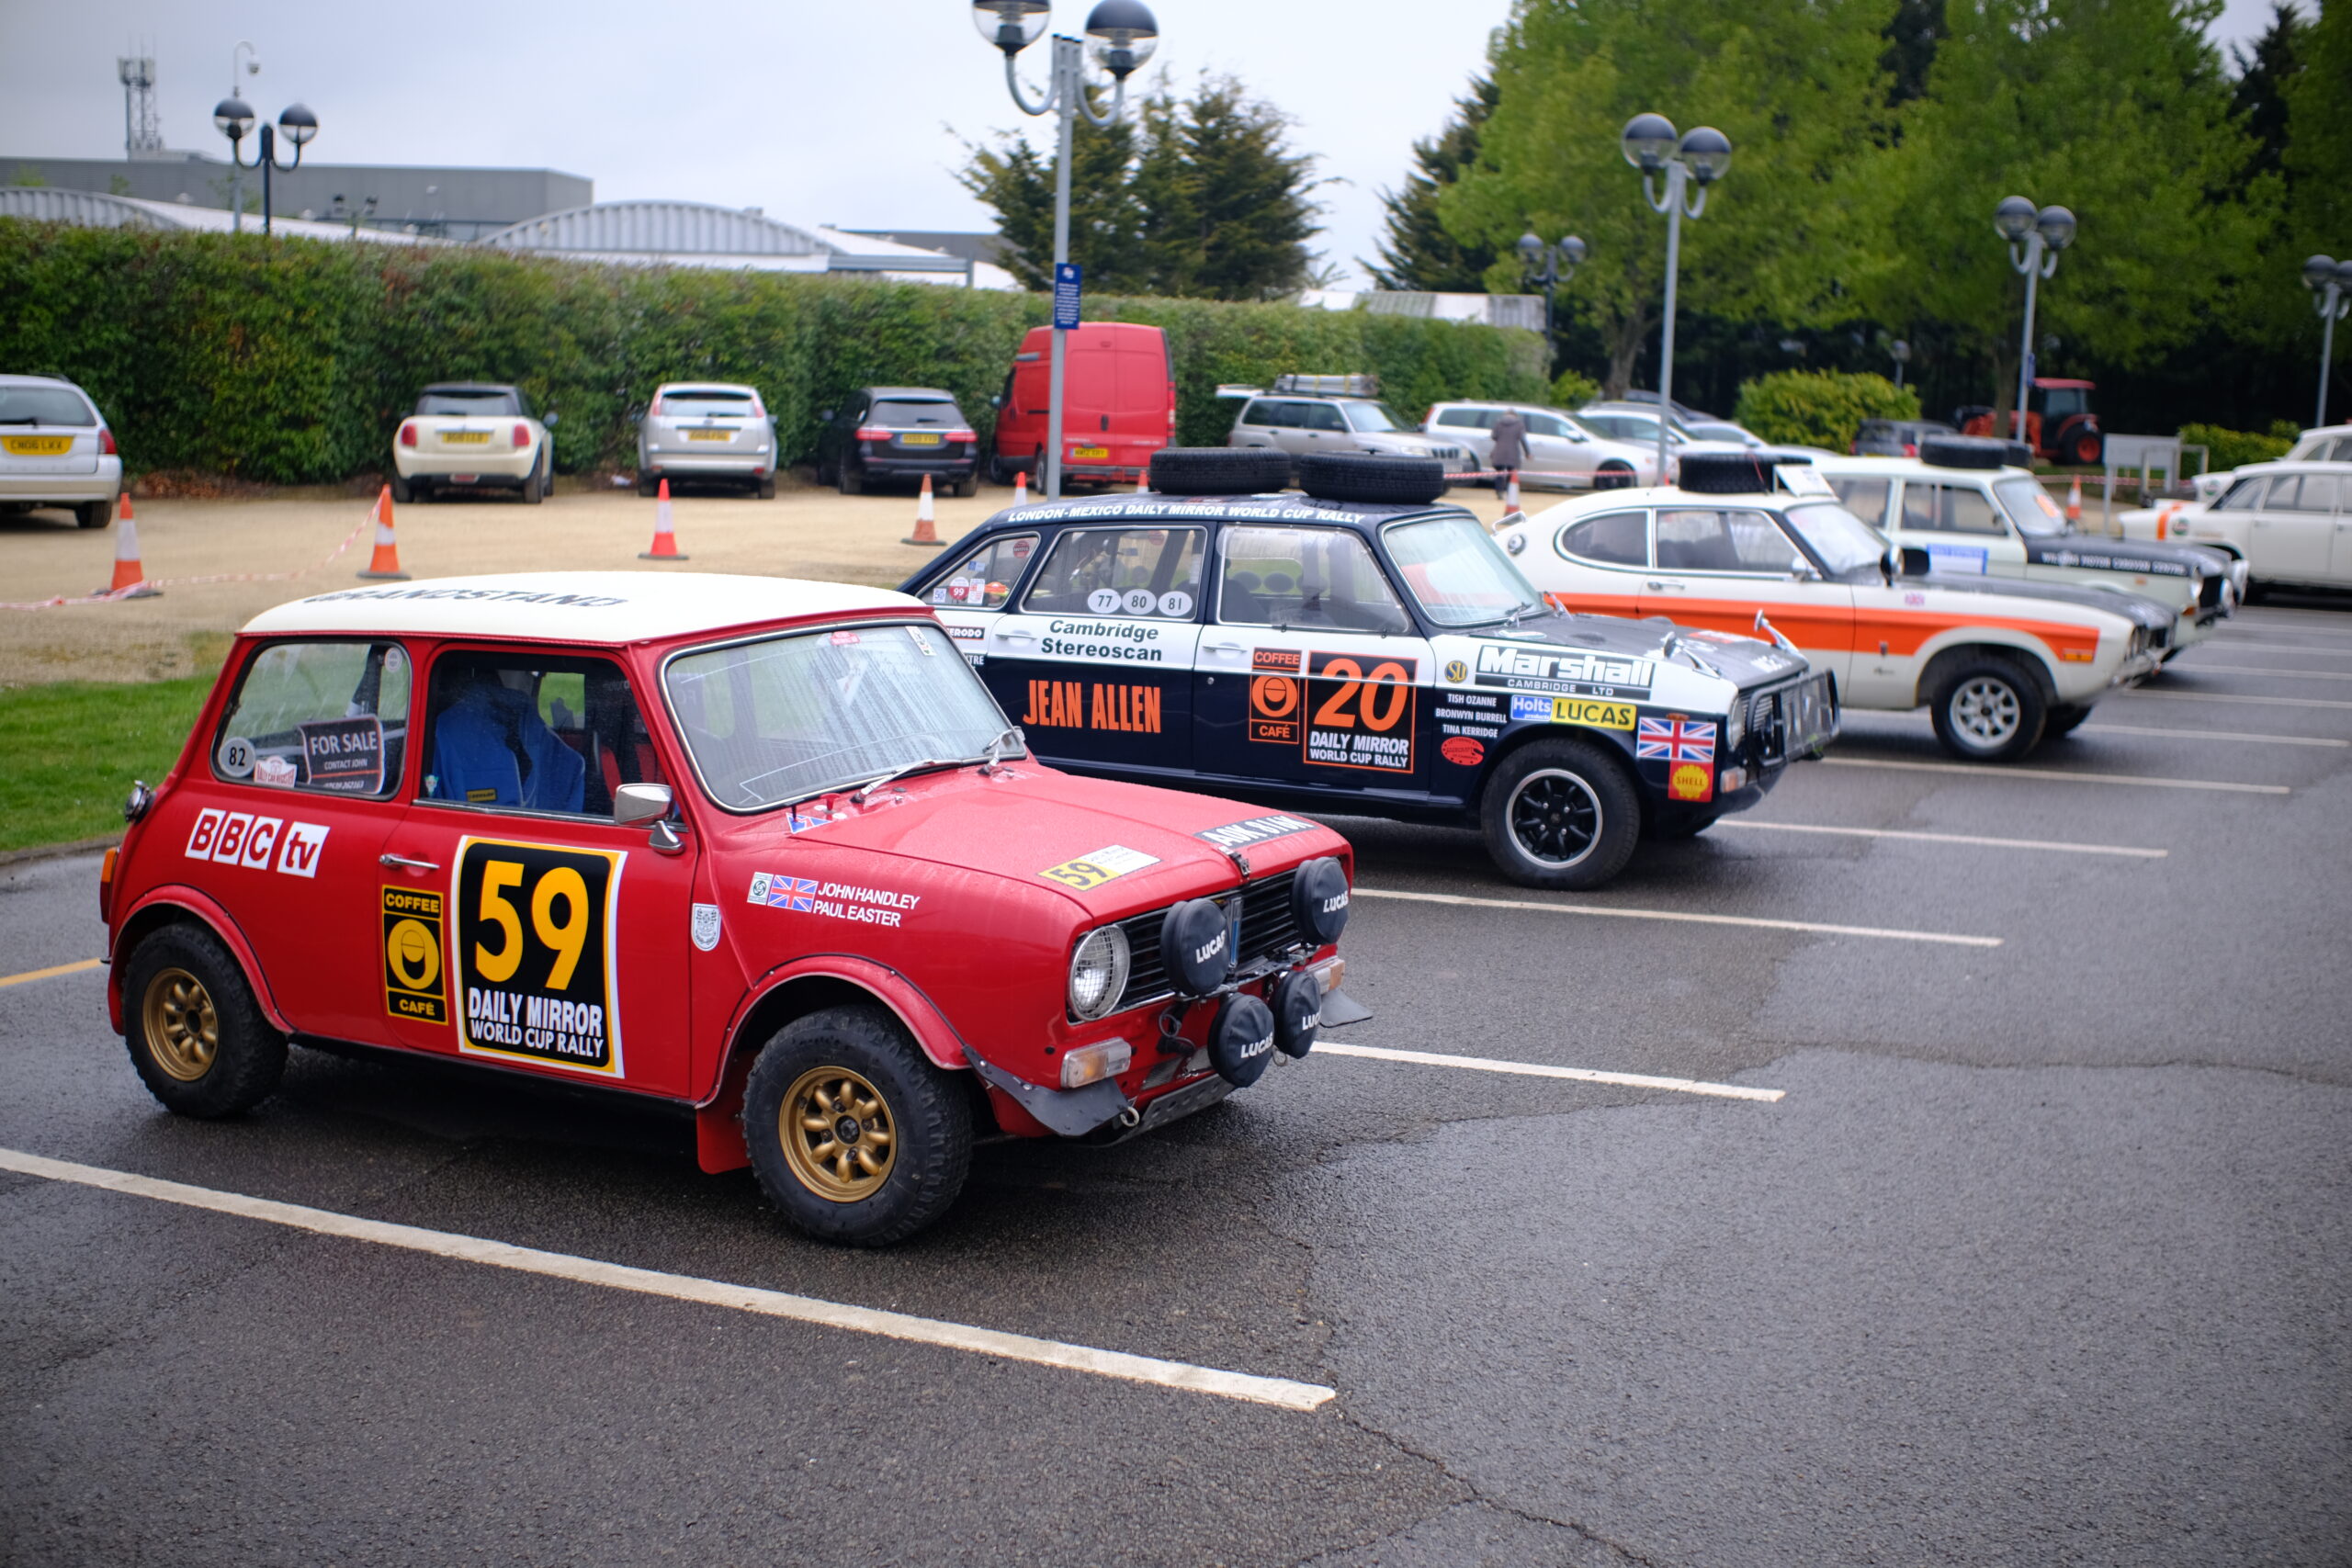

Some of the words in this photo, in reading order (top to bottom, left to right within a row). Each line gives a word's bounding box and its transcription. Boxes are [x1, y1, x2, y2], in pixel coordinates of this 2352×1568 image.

[1008, 505, 1122, 522] LONDON-MEXICO
[1125, 504, 1168, 514] DAILY
[1168, 505, 1225, 516] MIRROR
[1227, 507, 1279, 518] WORLD
[1283, 508, 1314, 519] CUP
[1316, 511, 1365, 524] RALLY
[954, 587, 965, 596] 99
[1098, 594, 1113, 607] 77
[1131, 595, 1148, 608] 80
[1168, 597, 1182, 611] 81
[1050, 619, 1159, 643] Cambridge
[1041, 637, 1162, 661] Stereoscan
[1254, 651, 1300, 665] COFFEE
[1478, 645, 1654, 686] Marshall
[1313, 658, 1408, 731] 20
[1507, 679, 1576, 693] CAMBRIDGE
[1592, 686, 1614, 696] LTD
[1023, 680, 1082, 728] JEAN
[1091, 682, 1161, 733] ALLEN
[1447, 693, 1464, 704] TISH
[1465, 694, 1498, 707] OZANNE
[1513, 697, 1552, 713] Holts
[1435, 707, 1474, 720] BRONWYN
[1476, 711, 1507, 724] BURRELL
[1555, 702, 1632, 726] LUCAS
[1259, 724, 1291, 739] CAFÉ
[1309, 731, 1351, 750] DAILY
[1353, 734, 1409, 755] MIRROR
[1442, 724, 1461, 734] TINA
[1462, 726, 1498, 739] KERRIDGE
[311, 735, 340, 756] FOR
[343, 731, 378, 752] SALE
[229, 746, 246, 766] 82
[324, 760, 350, 771] CONTACT
[351, 758, 368, 768] JOHN
[1309, 748, 1348, 762] WORLD
[1350, 752, 1373, 764] CUP
[1374, 754, 1408, 768] RALLY
[1676, 776, 1704, 787] SHELL
[190, 814, 275, 862] BBC
[285, 830, 319, 870] tv
[1202, 824, 1268, 846] AOK
[1244, 815, 1316, 834] 816K
[1049, 862, 1108, 886] 59
[385, 893, 439, 912] COFFEE
[818, 883, 855, 900] JOHN
[855, 887, 920, 910] HANDLEY
[1323, 890, 1349, 913] LUCAS
[475, 860, 589, 990] 59
[813, 901, 848, 919] PAUL
[848, 907, 901, 928] EASTER
[1195, 930, 1226, 964] LUCAS
[399, 998, 435, 1016] CAFÉ
[468, 987, 524, 1025] DAILY
[526, 995, 603, 1038] MIRROR
[470, 1019, 522, 1045] WORLD
[525, 1028, 554, 1050] CUP
[557, 1033, 604, 1058] RALLY
[1241, 1032, 1273, 1058] LUCAS
